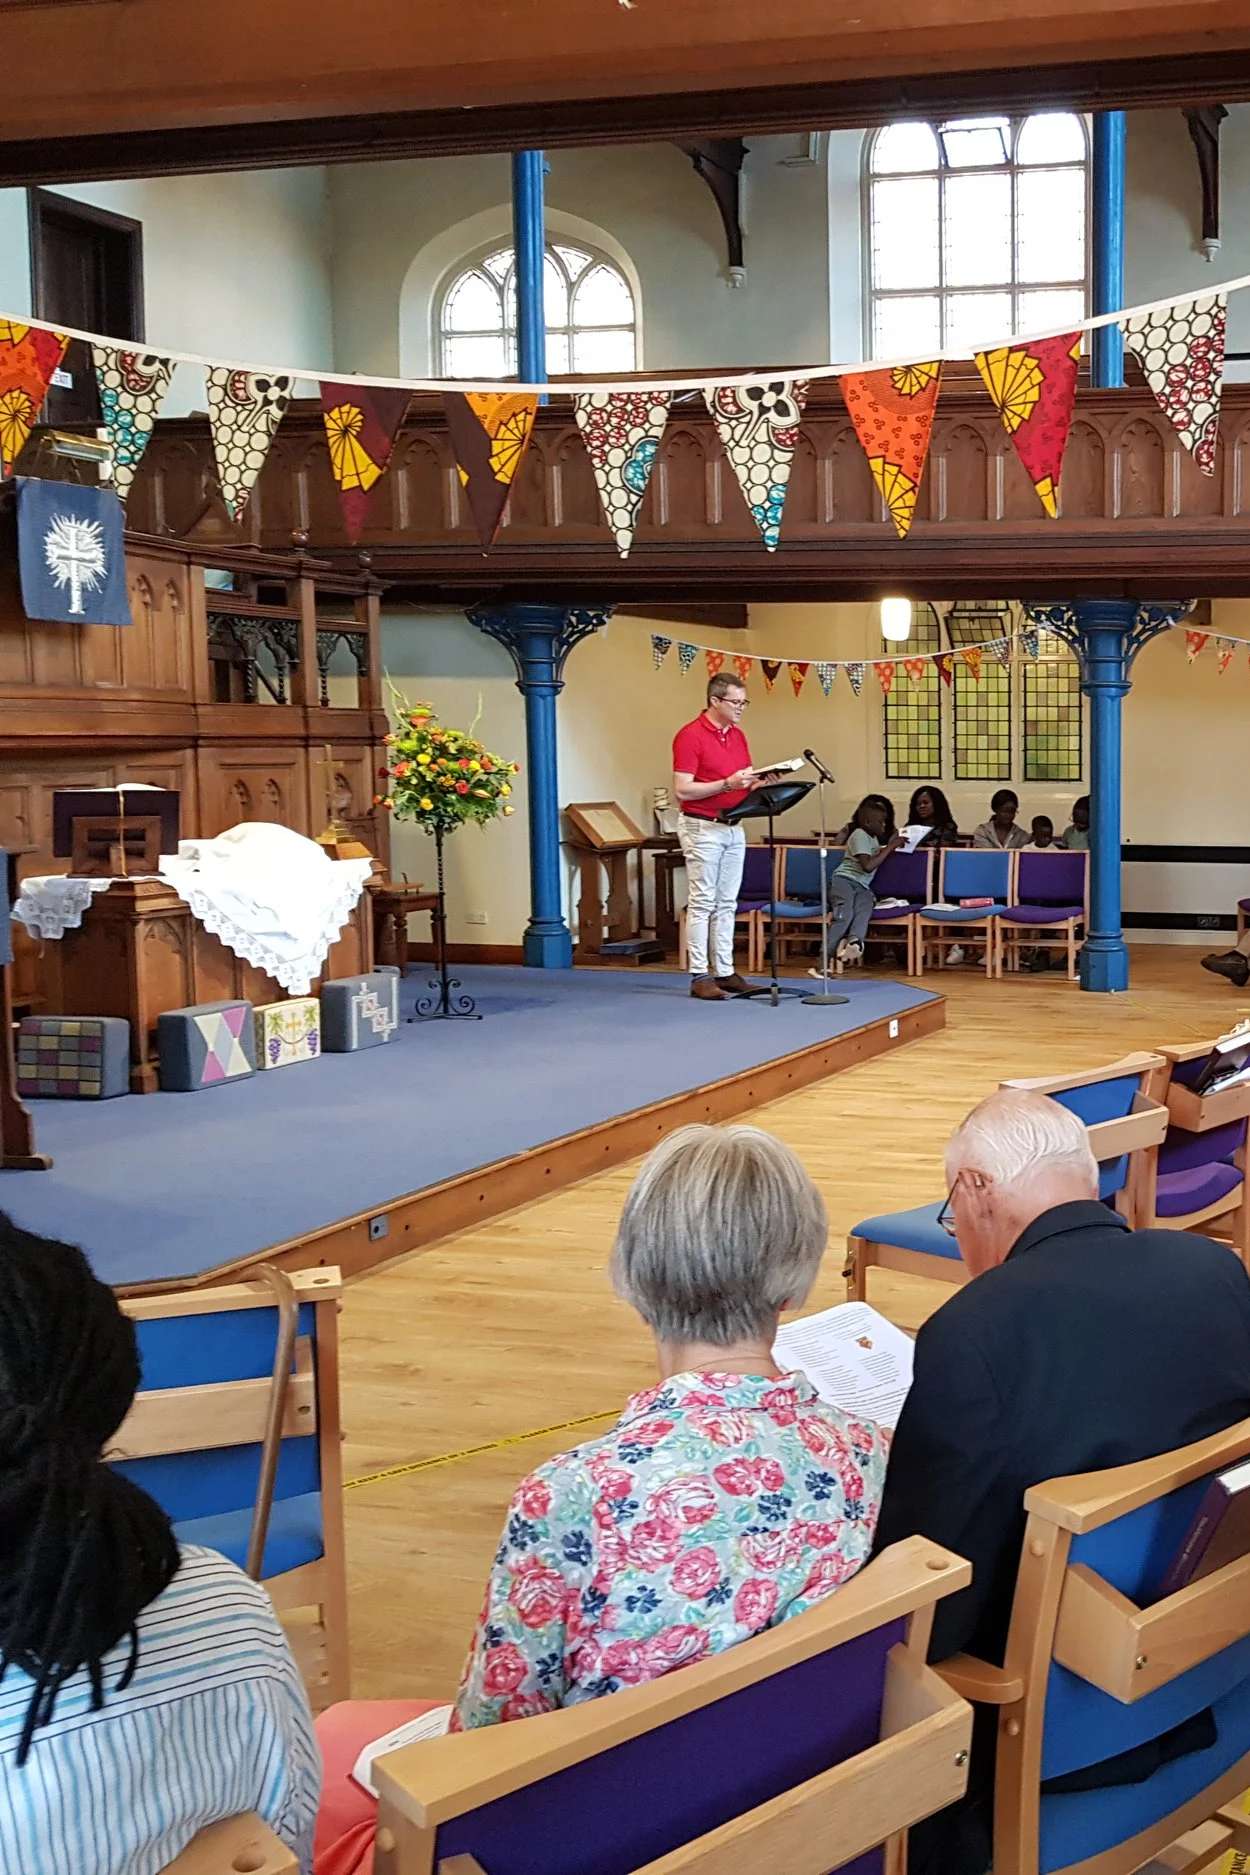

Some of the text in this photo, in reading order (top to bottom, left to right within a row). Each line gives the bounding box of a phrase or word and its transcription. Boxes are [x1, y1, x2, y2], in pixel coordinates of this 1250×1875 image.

[357, 1475, 379, 1483] KEEP
[387, 1466, 408, 1476] SAFE
[408, 1456, 447, 1469] DISTANCE
